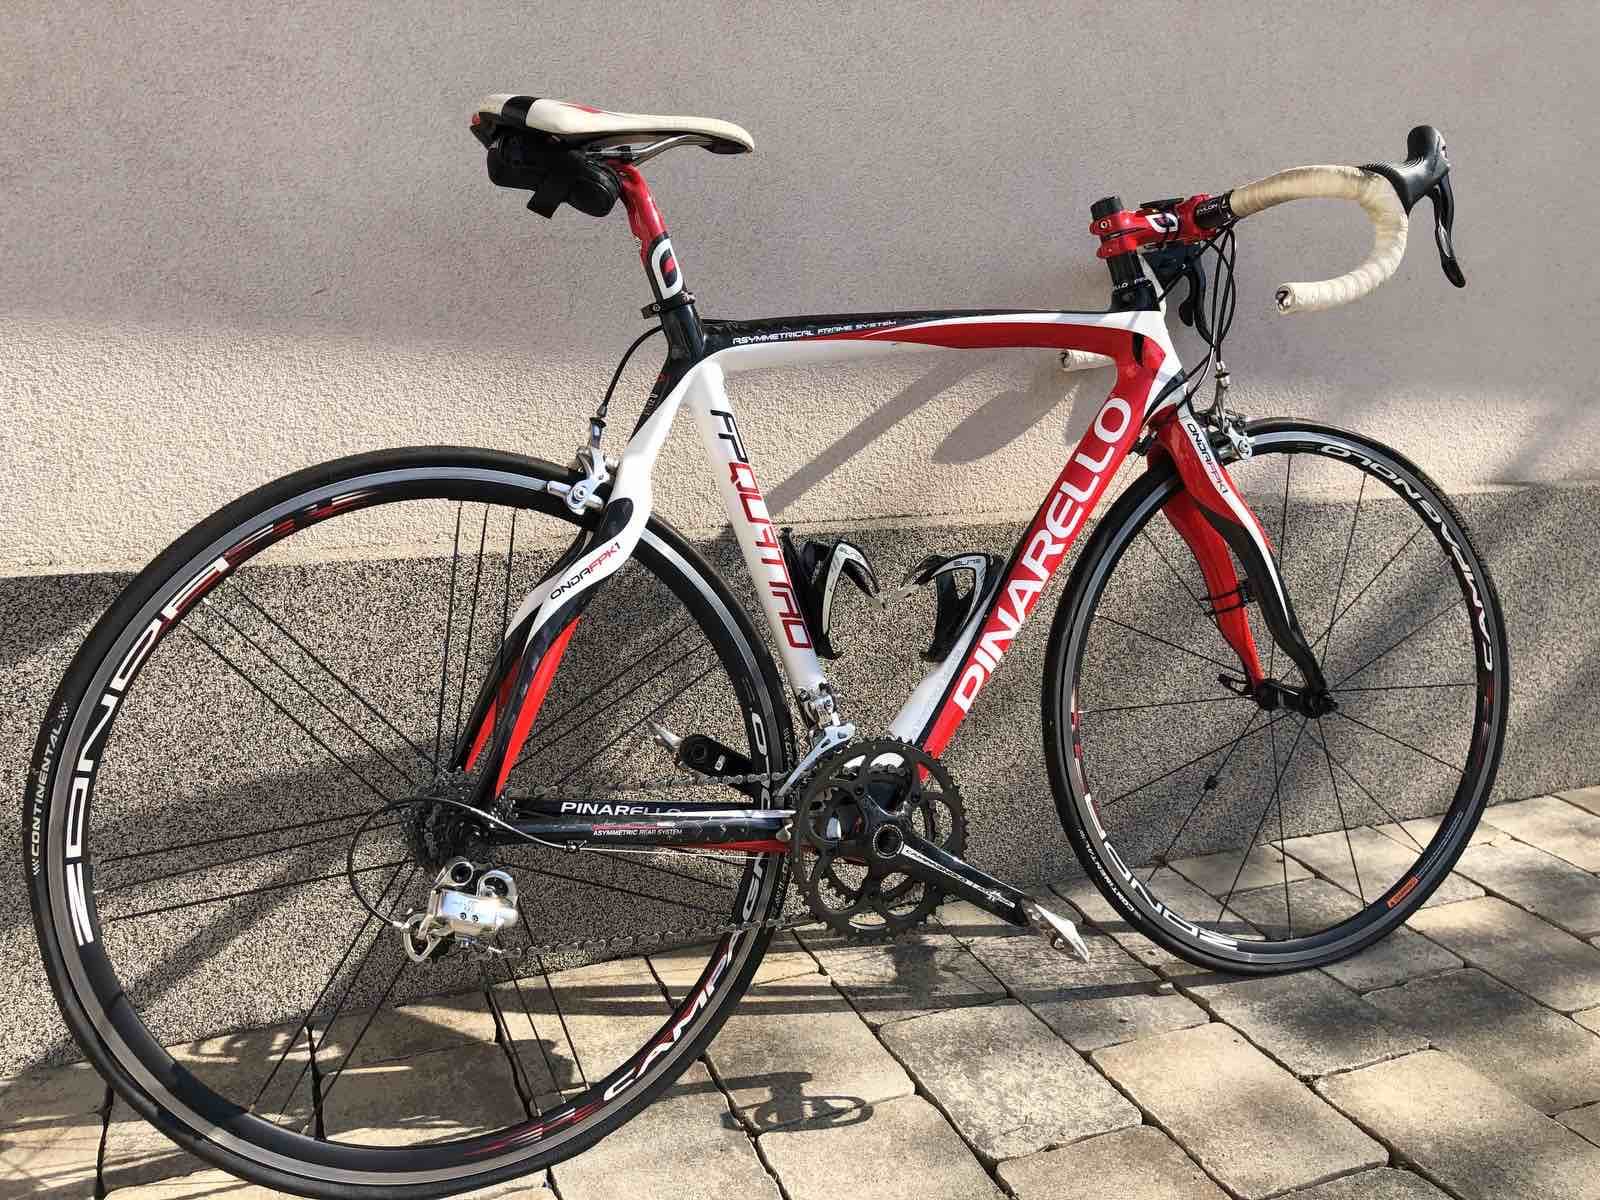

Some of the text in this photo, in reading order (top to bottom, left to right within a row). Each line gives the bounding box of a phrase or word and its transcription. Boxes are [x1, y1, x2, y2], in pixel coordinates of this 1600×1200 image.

[733, 320, 897, 345] ASYMMETRICAL FRAME SYSTEM
[952, 397, 1132, 713] PINARELLO
[1320, 445, 1494, 672] CAMPAGNOLO
[31, 723, 64, 857] CONTINENTAL
[65, 557, 230, 947] ZONDA
[560, 802, 683, 817] PINARELLO
[593, 829, 639, 837] ASYMMETRIC
[1083, 793, 1239, 951] ZONDA
[1084, 842, 1135, 913] CONTINENTAL
